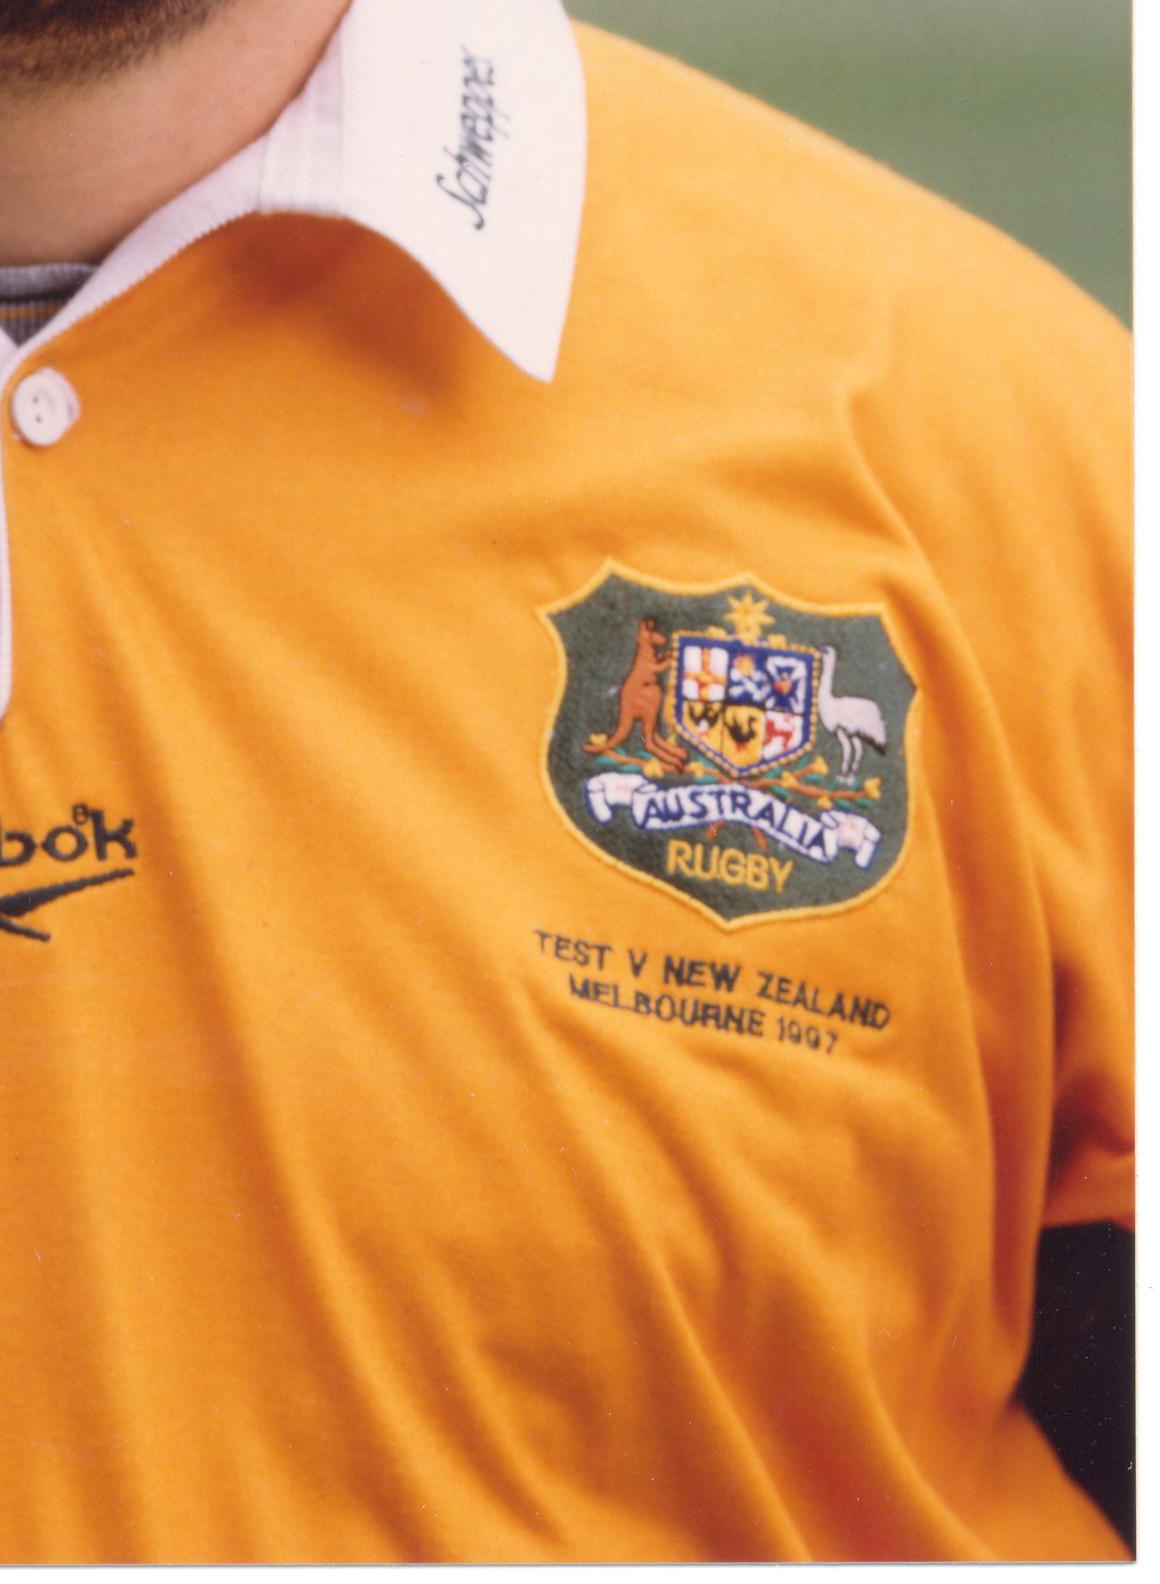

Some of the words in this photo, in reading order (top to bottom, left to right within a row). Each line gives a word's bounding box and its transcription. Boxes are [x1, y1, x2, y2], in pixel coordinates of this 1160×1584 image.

[639, 786, 830, 854] AUSTRALIA
[666, 839, 793, 894] RUGBY
[534, 928, 611, 970] TEST
[628, 948, 647, 978] V
[663, 954, 741, 993] NEW
[756, 971, 891, 1030] ZEALAND
[568, 973, 766, 1038] MELBOURNE
[777, 1018, 839, 1055] 1997
